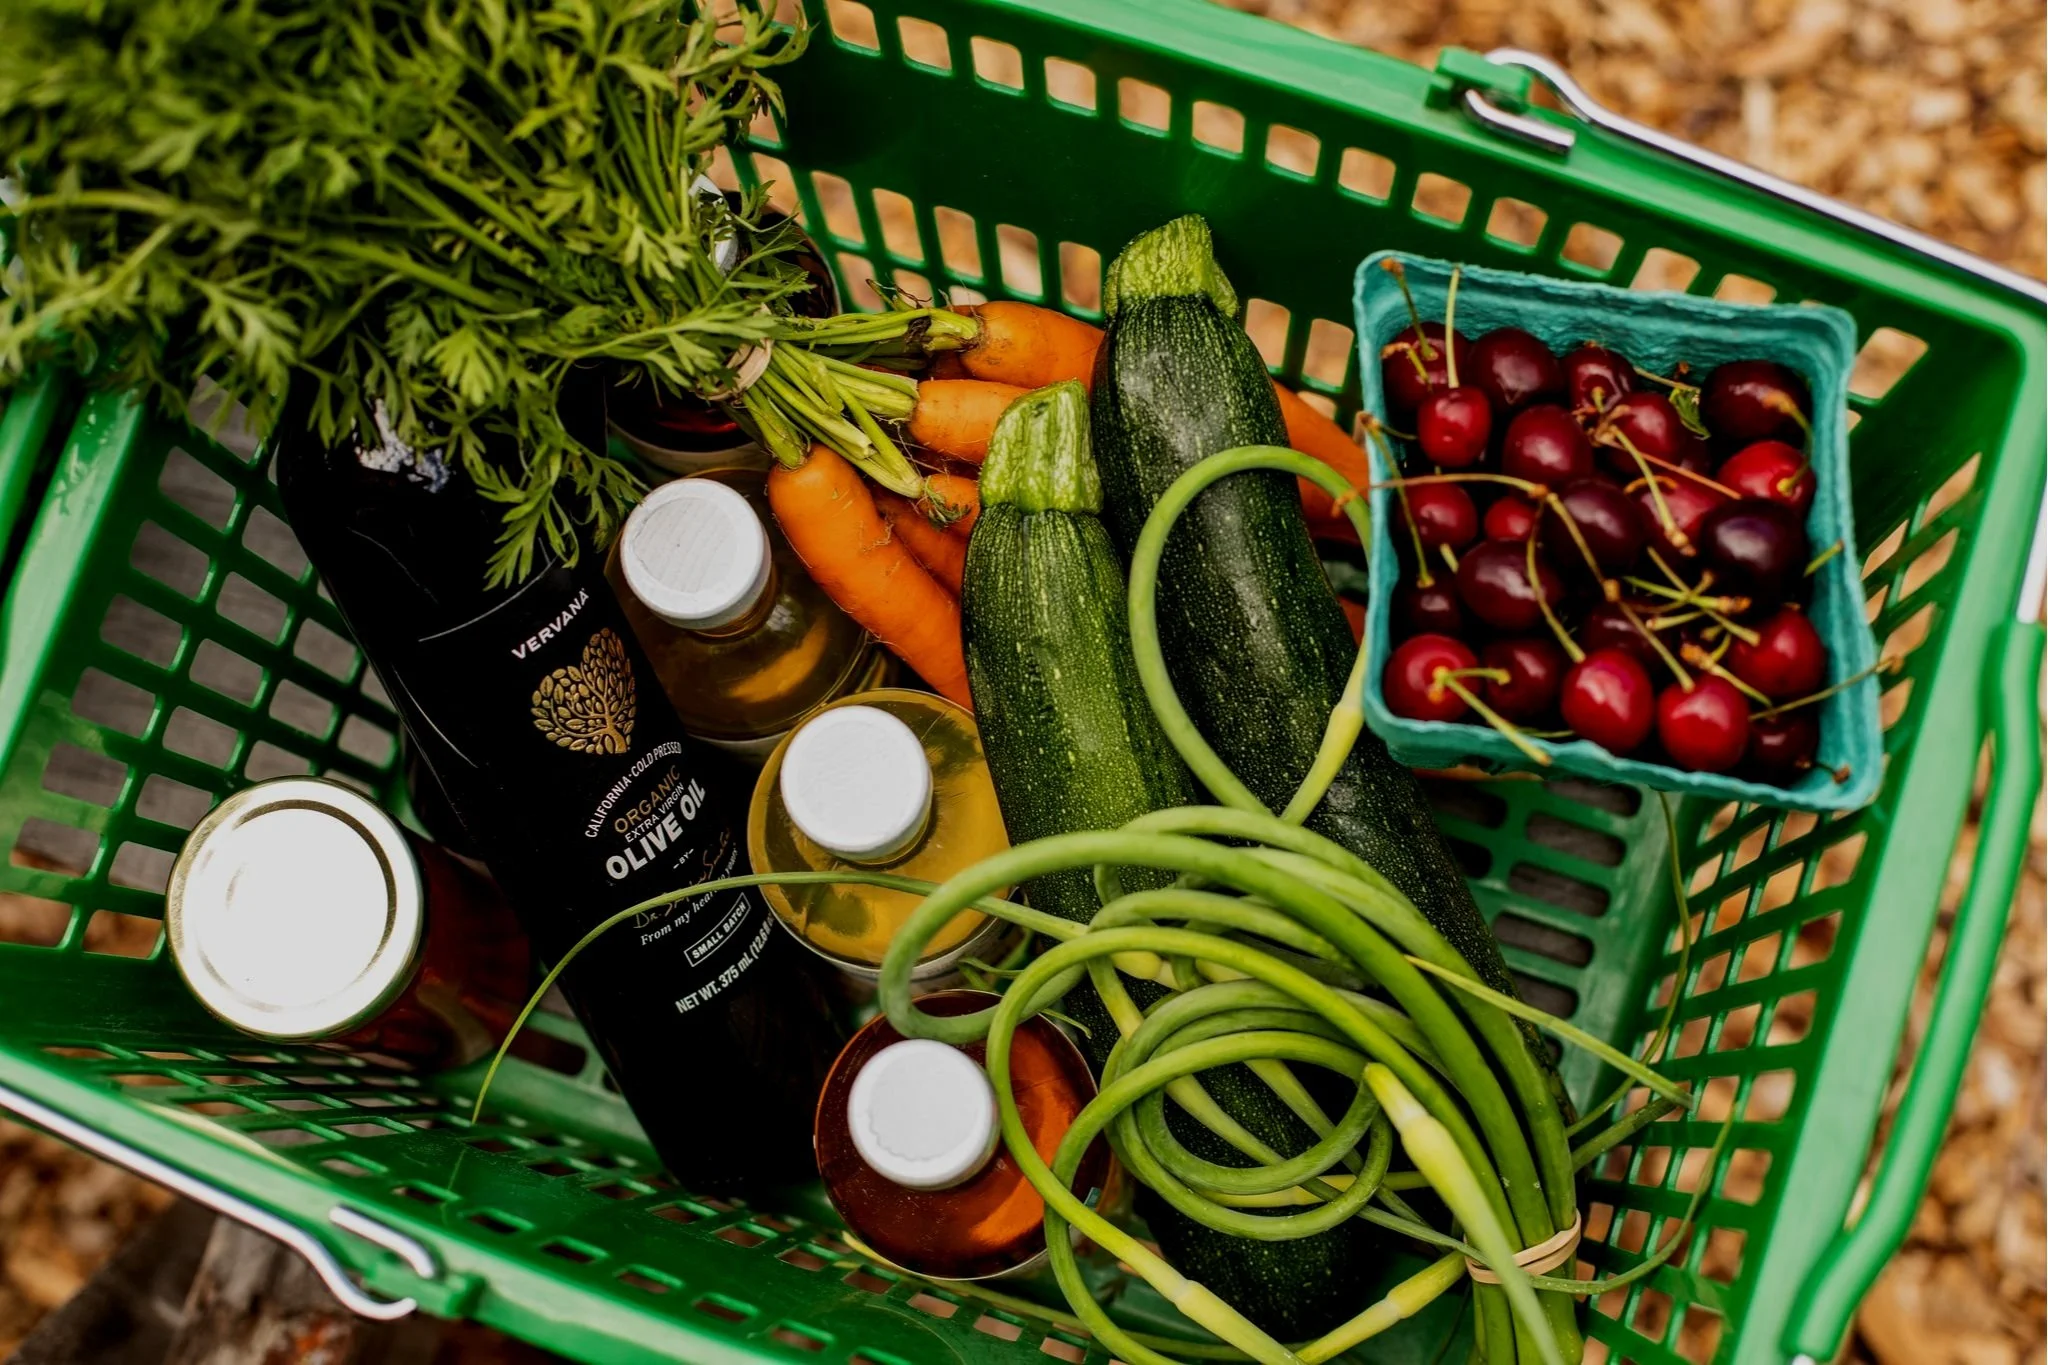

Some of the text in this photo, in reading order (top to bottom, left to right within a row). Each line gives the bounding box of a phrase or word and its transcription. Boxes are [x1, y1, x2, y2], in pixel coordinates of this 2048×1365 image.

[585, 775, 632, 838] CALIFORNIA
[631, 752, 654, 777] COLD
[614, 765, 681, 833] ORGANIC
[625, 782, 685, 843] EXTRA VIRGIN
[606, 811, 683, 880] OLIVE
[680, 778, 706, 820] OIL
[641, 924, 672, 946] From
[674, 910, 691, 928] my
[692, 890, 718, 913] hear
[691, 901, 747, 960] SMALL BATCH
[675, 992, 698, 1014] NET
[698, 980, 722, 1001] WT.
[718, 964, 740, 988] 375
[737, 952, 754, 973] mL
